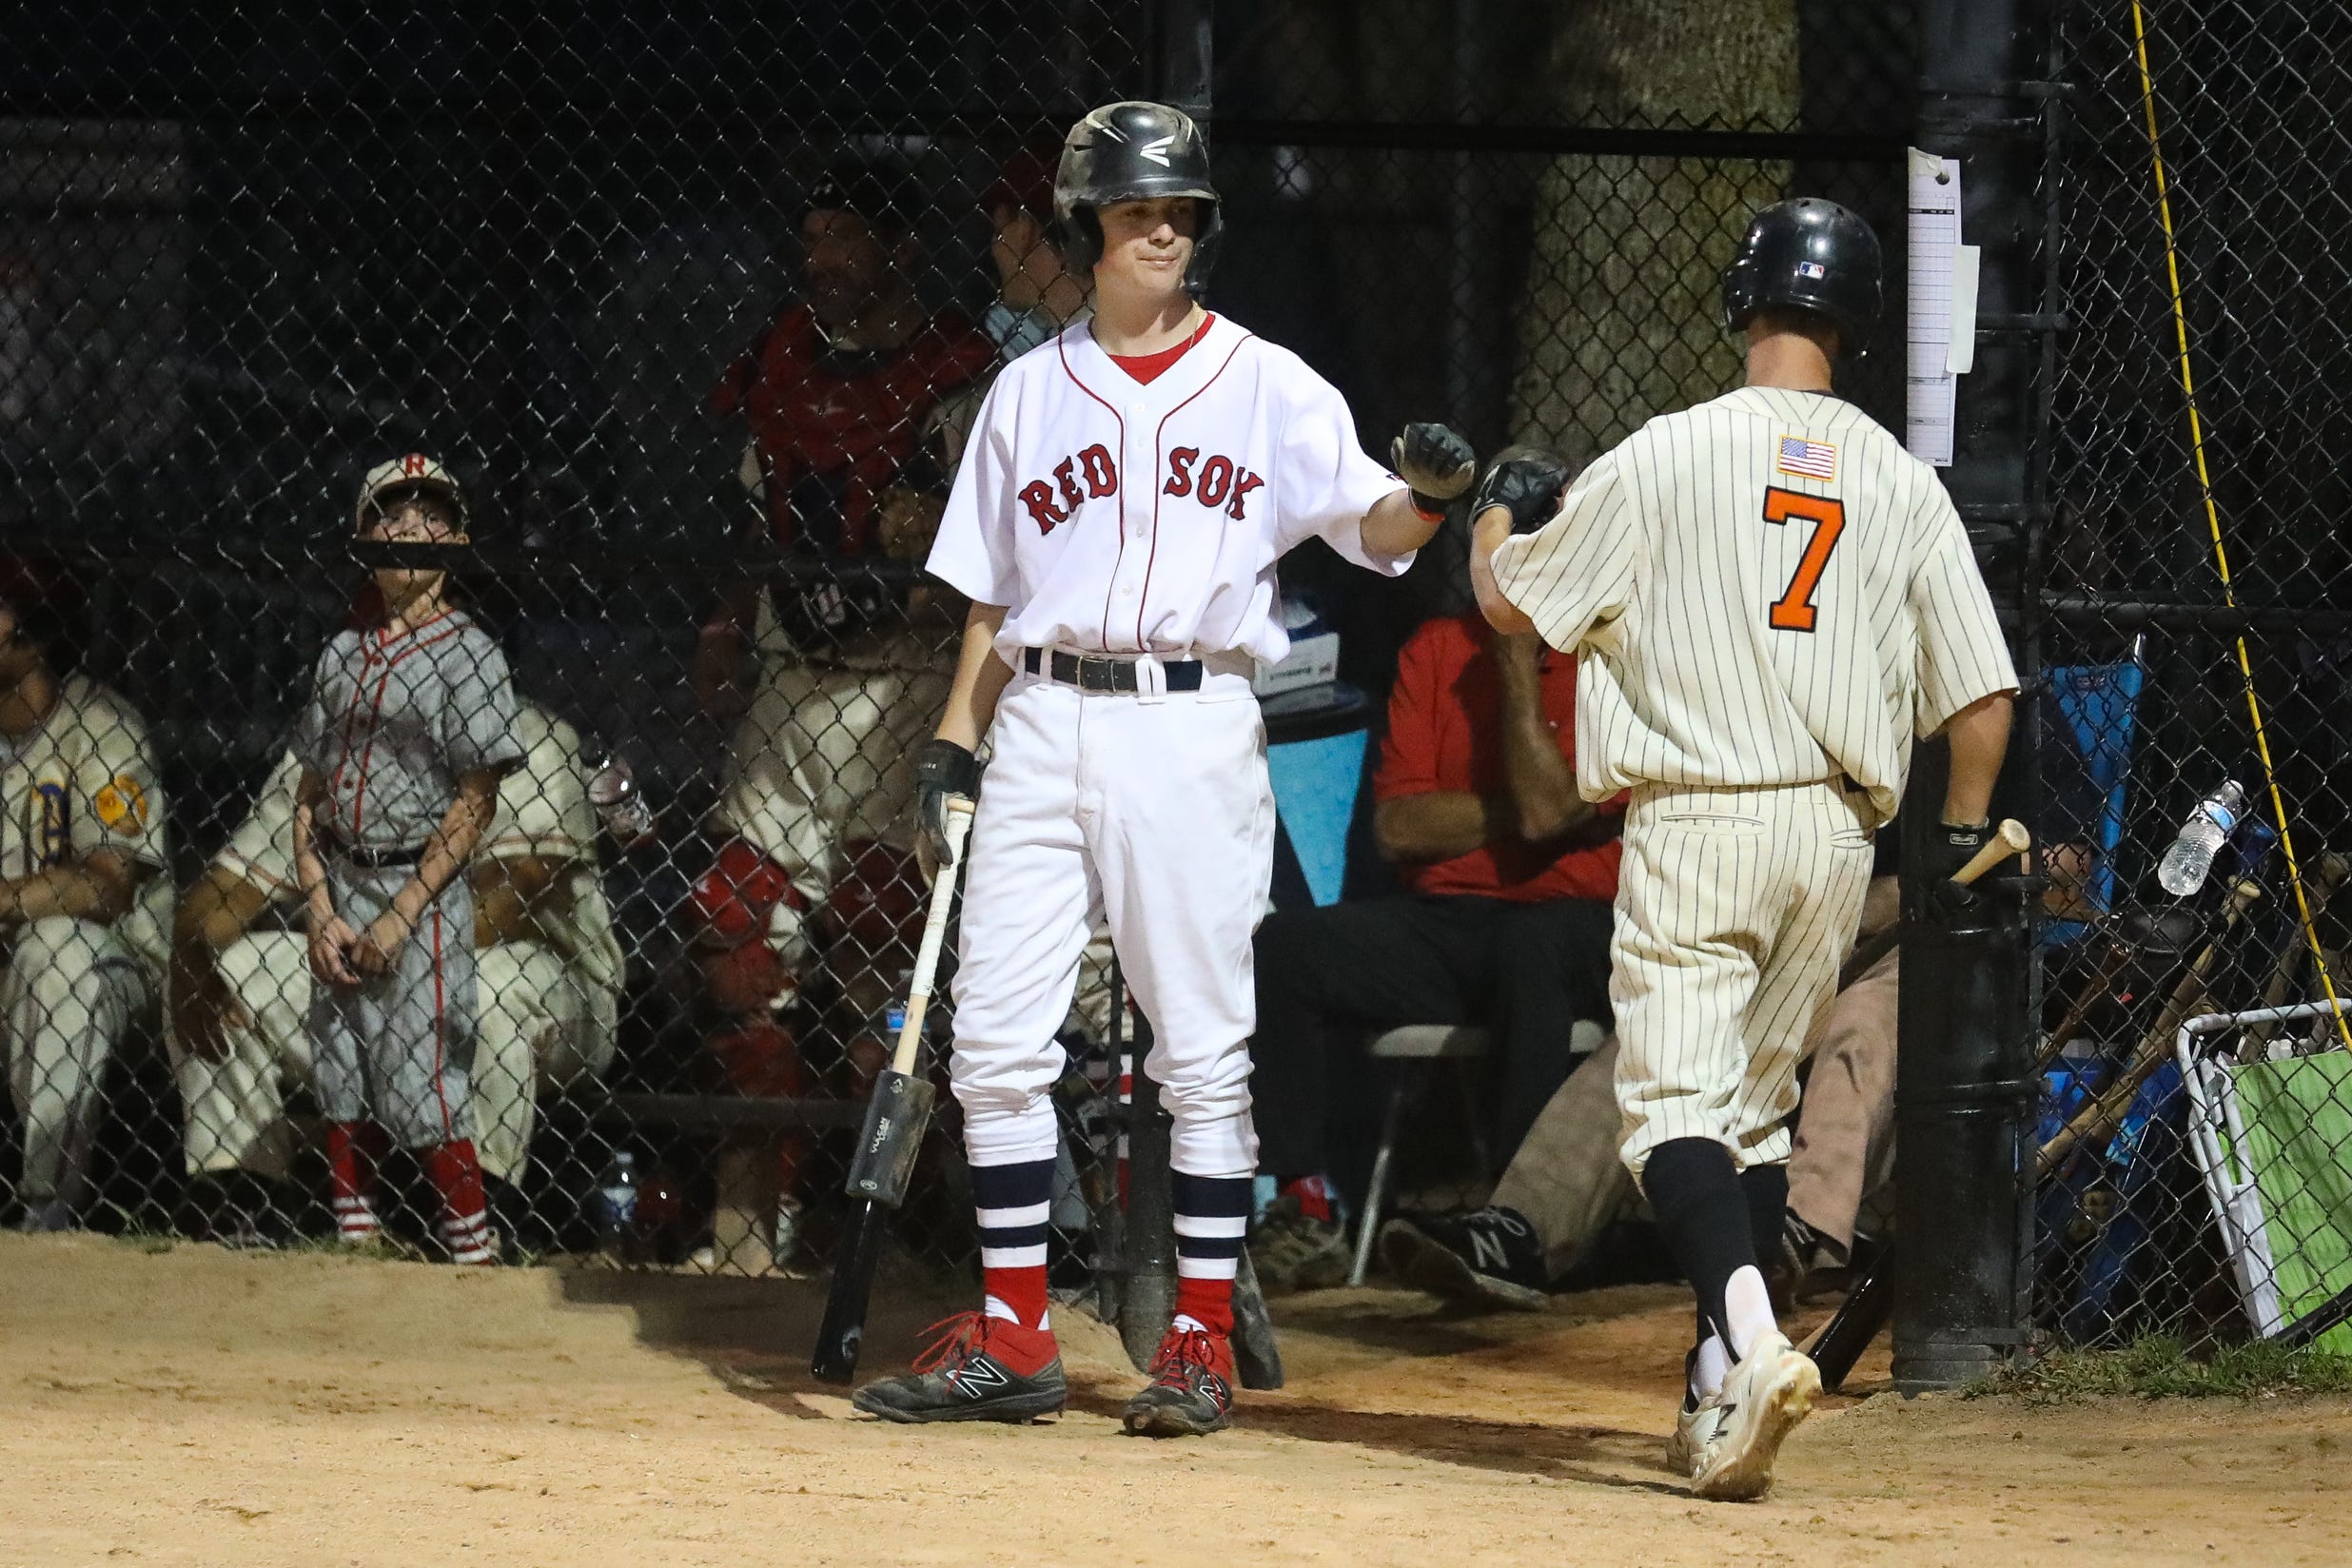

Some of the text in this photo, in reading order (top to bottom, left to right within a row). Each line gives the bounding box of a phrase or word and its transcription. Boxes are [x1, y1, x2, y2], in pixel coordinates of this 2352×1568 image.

[405, 452, 425, 476] R
[1018, 443, 1264, 536] RED SOX
[1762, 485, 1846, 633] 7
[1469, 1227, 1509, 1269] N
[946, 1357, 1009, 1400] N
